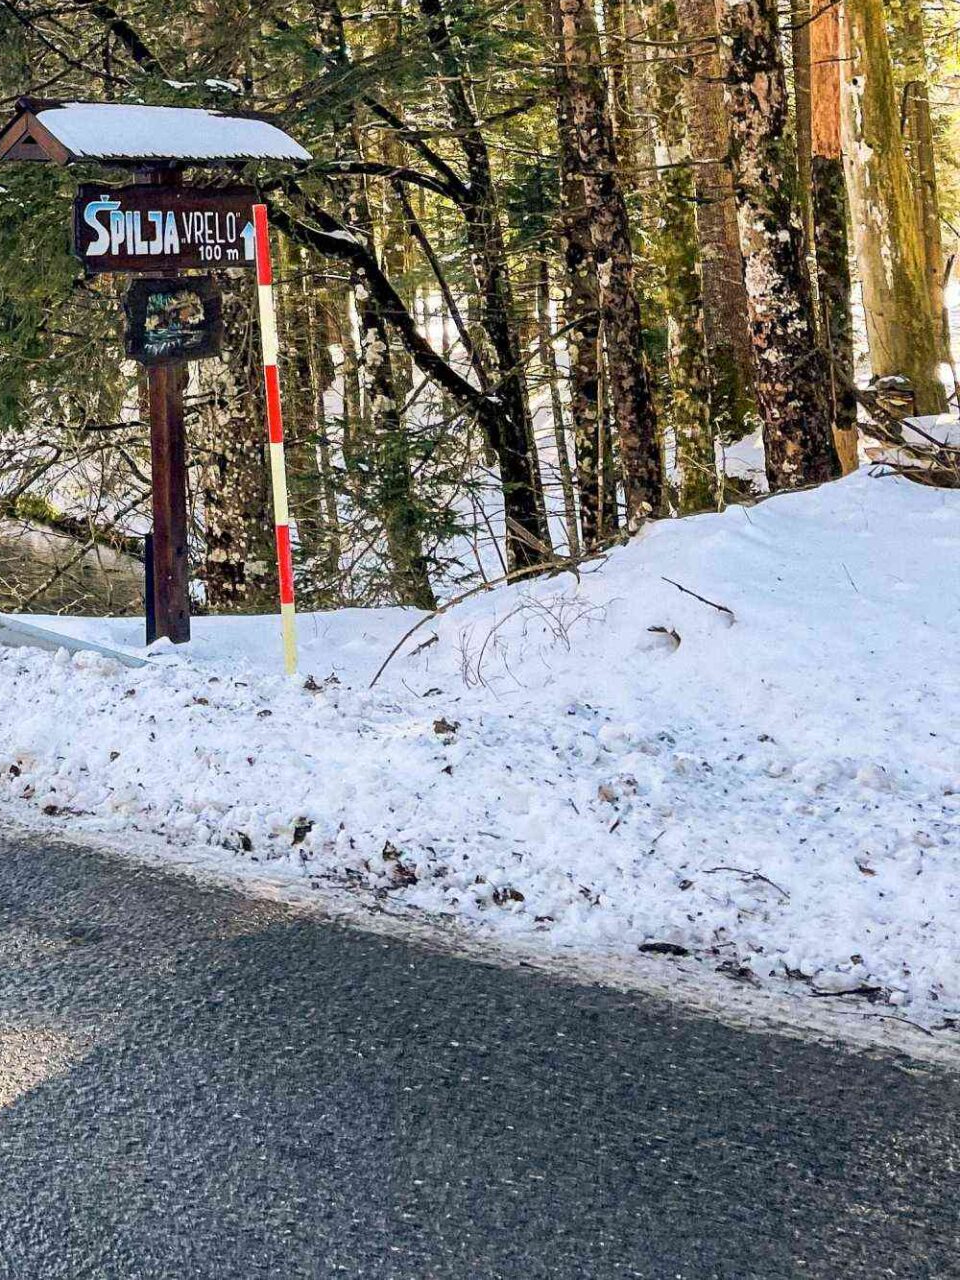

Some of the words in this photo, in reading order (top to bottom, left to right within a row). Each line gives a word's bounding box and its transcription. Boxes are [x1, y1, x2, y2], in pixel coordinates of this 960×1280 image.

[83, 195, 180, 256] ŠPILJA
[198, 245, 222, 261] 100
[226, 249, 239, 261] m
